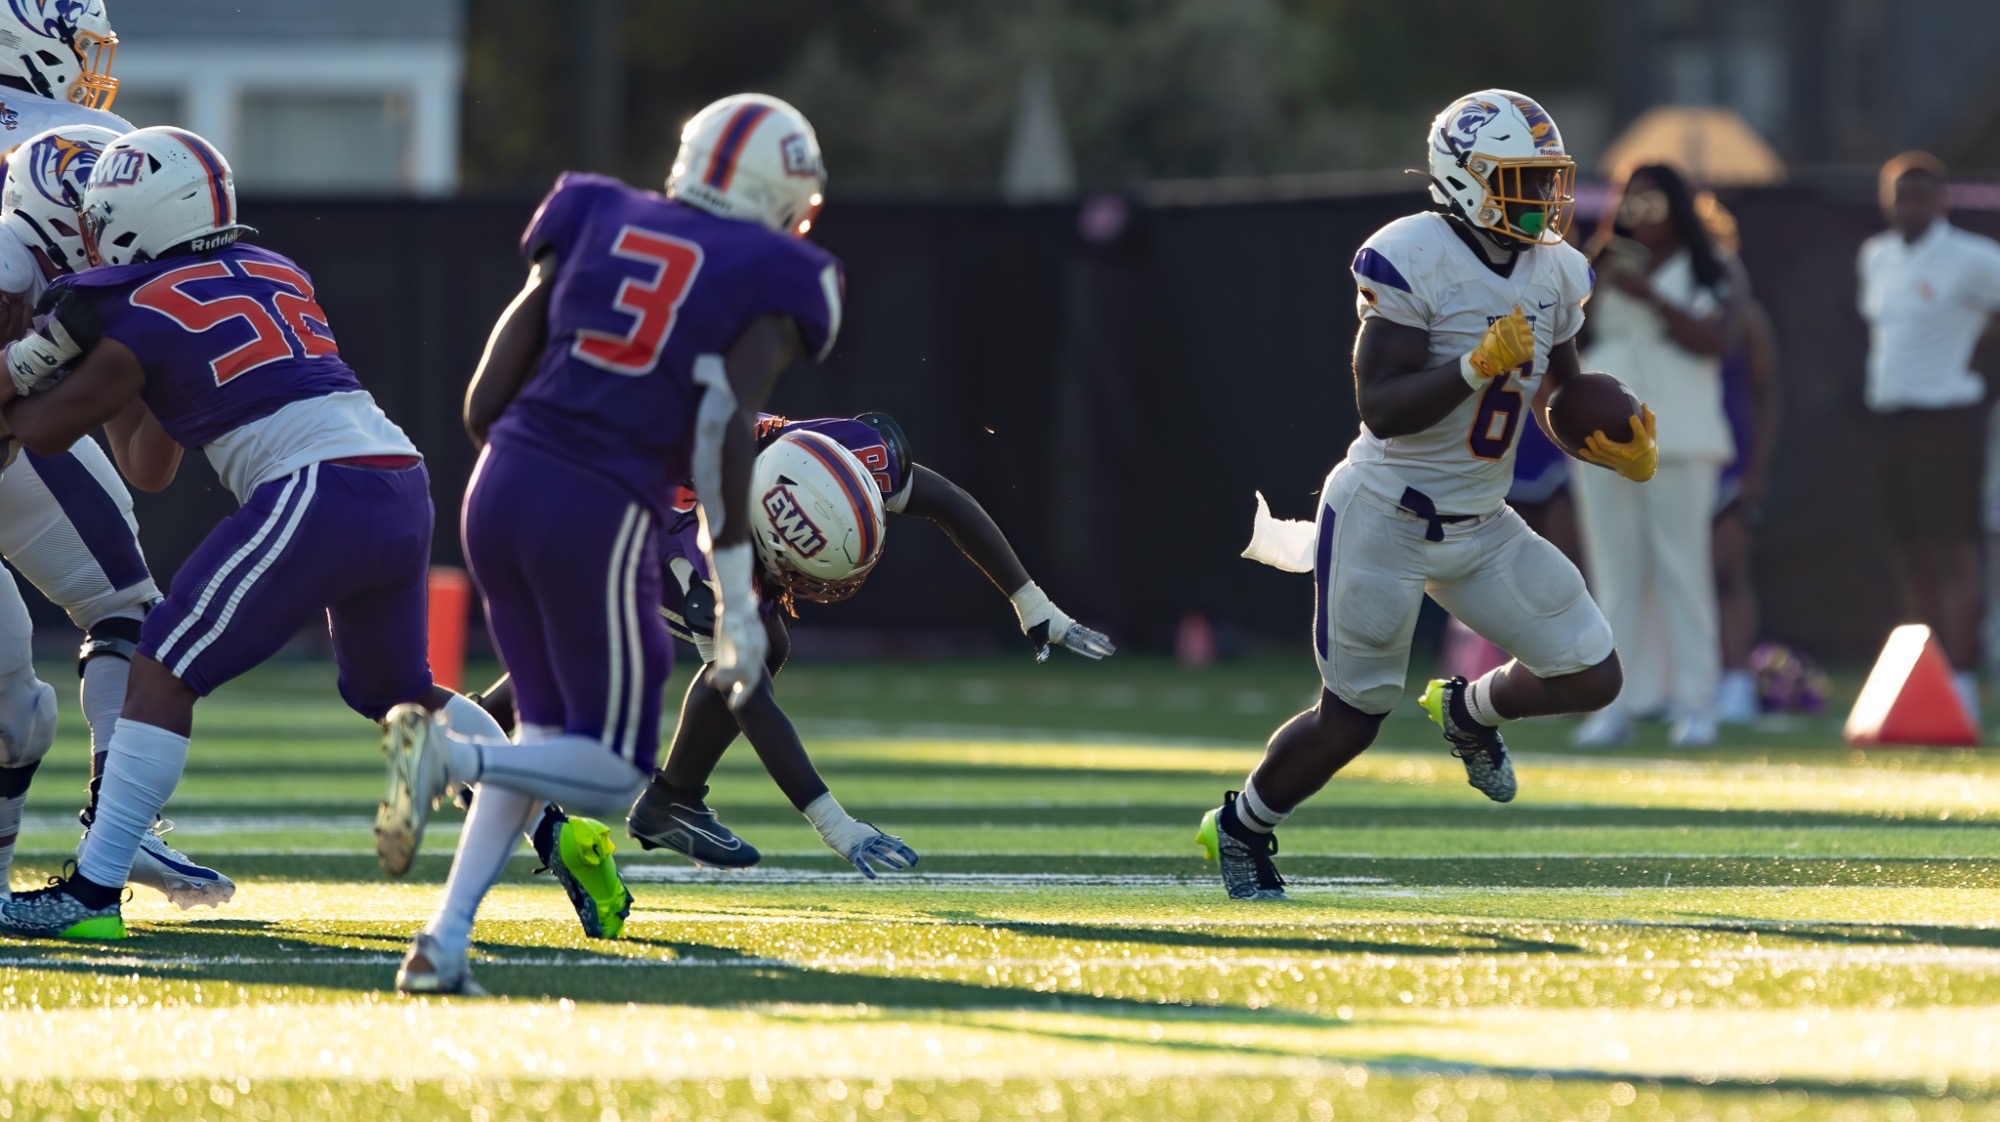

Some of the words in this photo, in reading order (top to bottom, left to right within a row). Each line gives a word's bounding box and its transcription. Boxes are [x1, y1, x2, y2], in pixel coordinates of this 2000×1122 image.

[129, 259, 339, 388] 52
[571, 225, 705, 377] 3
[1466, 360, 1535, 462] 6
[763, 487, 825, 557] EWU
